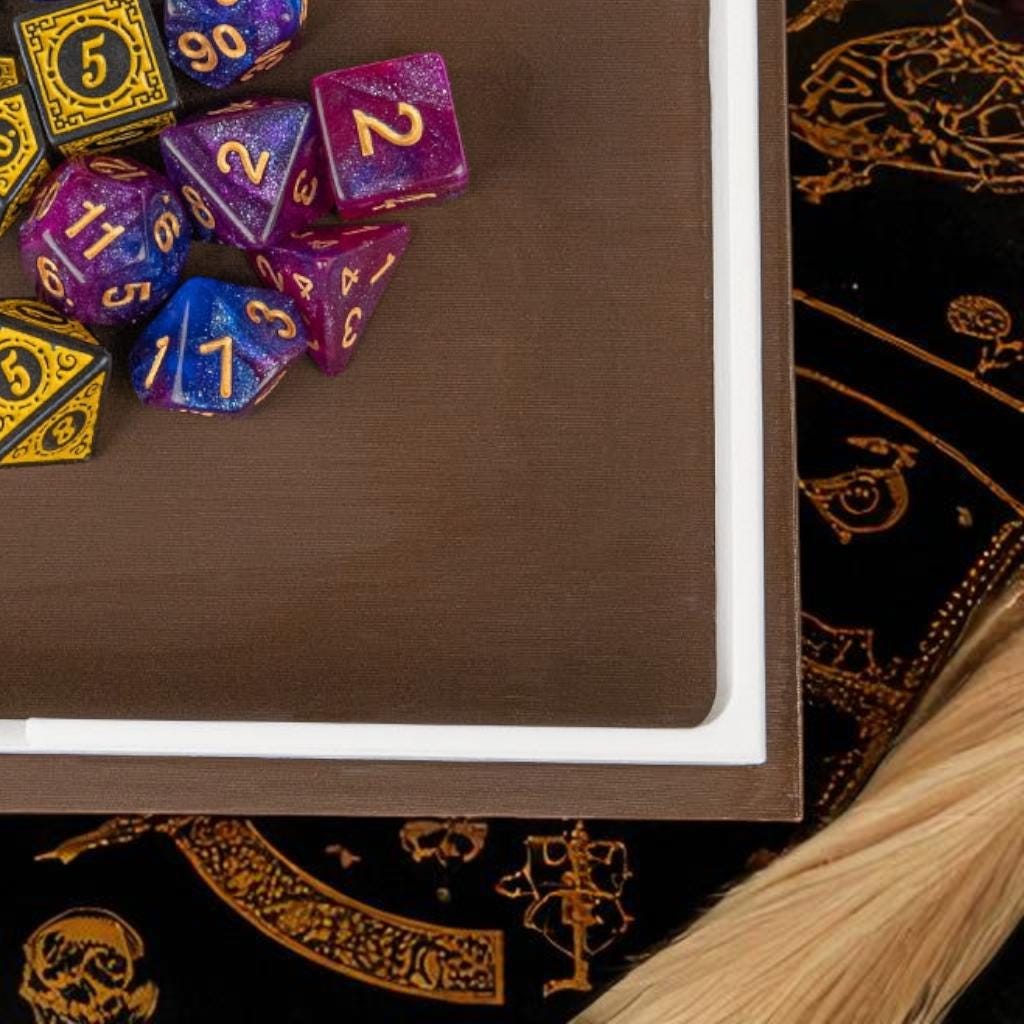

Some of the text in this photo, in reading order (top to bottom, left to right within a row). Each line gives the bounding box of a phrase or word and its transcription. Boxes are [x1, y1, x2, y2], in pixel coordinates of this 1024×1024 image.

[81, 32, 107, 90] 5
[177, 23, 247, 73] 90
[352, 101, 424, 157] 2
[217, 140, 270, 184] 2
[64, 200, 126, 261] 11
[102, 282, 152, 308] 5
[292, 273, 314, 301] 4
[341, 266, 361, 296] 4
[246, 300, 296, 339] 3
[341, 306, 363, 348] 3
[0, 349, 31, 396] 5
[145, 335, 170, 389] 1
[199, 336, 233, 398] 7
[52, 415, 76, 445] 8
